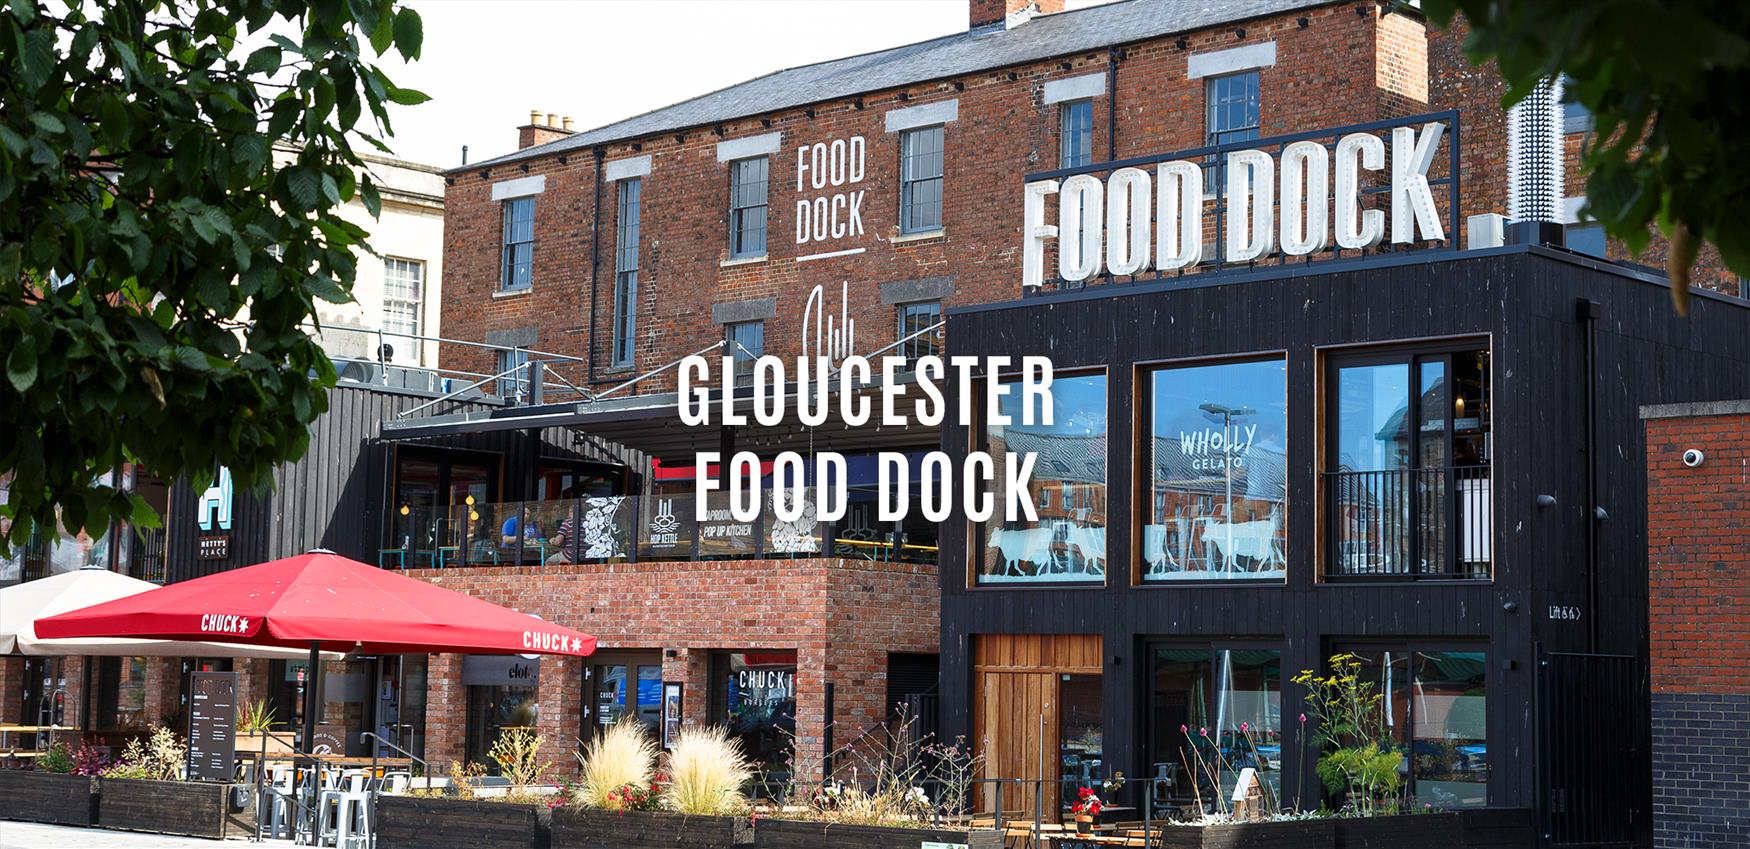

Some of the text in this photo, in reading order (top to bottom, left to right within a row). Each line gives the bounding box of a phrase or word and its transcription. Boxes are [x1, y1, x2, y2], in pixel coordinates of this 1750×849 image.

[797, 136, 865, 192] FOOD
[1023, 122, 1446, 286] FOOD DOCK
[796, 190, 865, 244] DOCK
[1180, 424, 1257, 456] WHOLLY
[1192, 457, 1243, 470] GELATO
[650, 533, 678, 544] HOP KETTLE
[703, 524, 752, 537] POP UP KITCHEN
[201, 548, 226, 556] PLACE
[1549, 605, 1561, 619] Lift
[201, 613, 240, 633] CHUCK
[523, 631, 570, 652] CHUCK
[739, 670, 785, 689] CHUCK
